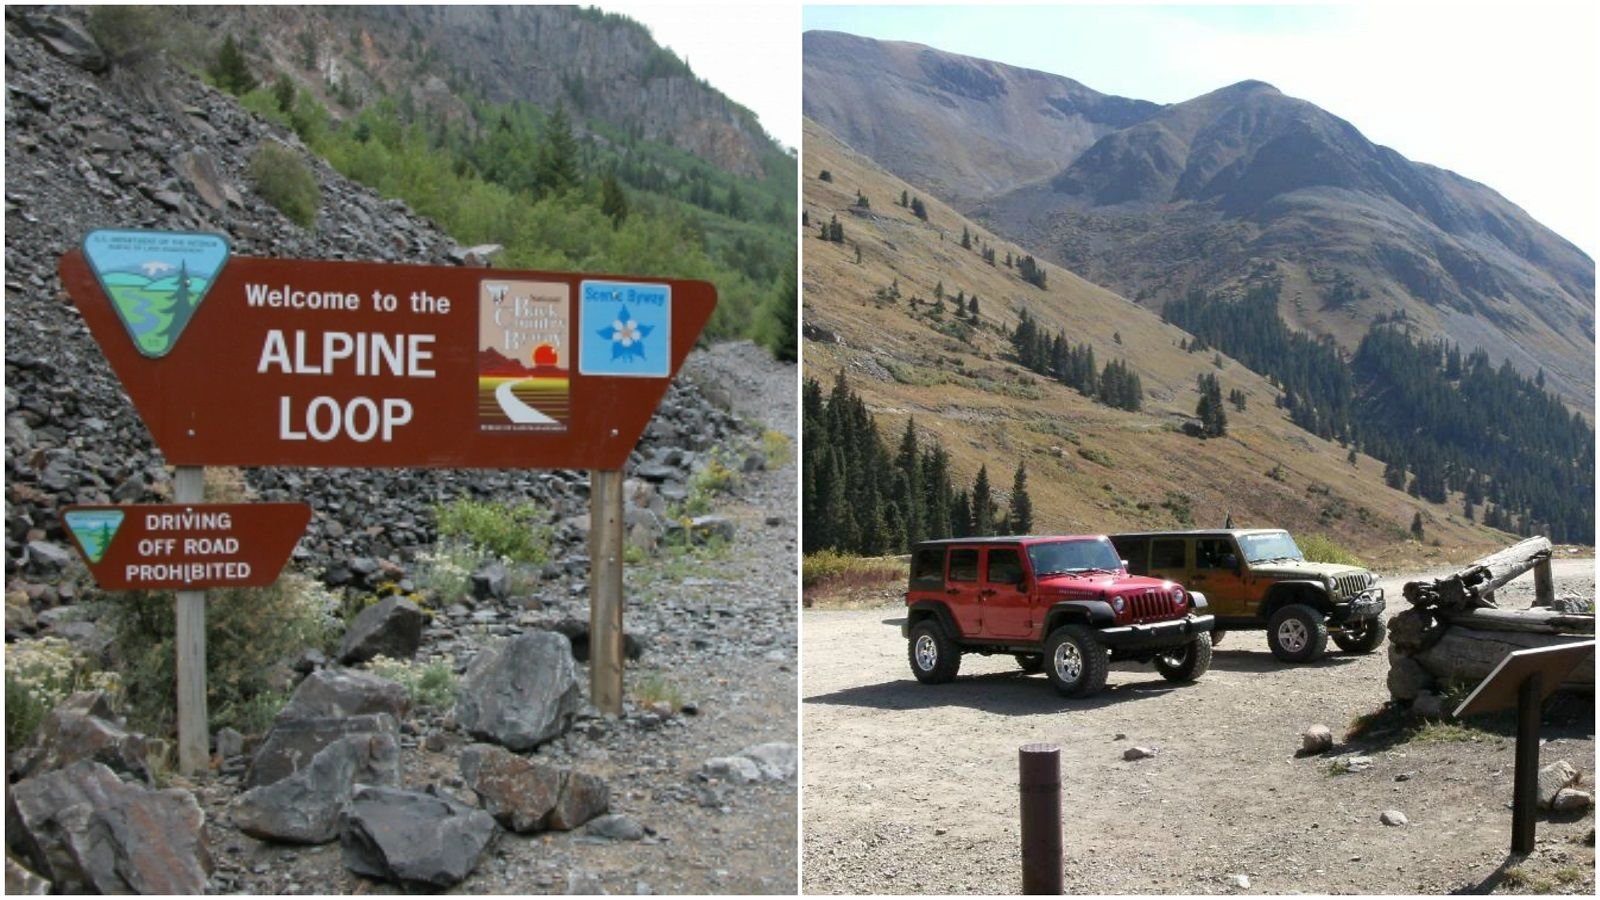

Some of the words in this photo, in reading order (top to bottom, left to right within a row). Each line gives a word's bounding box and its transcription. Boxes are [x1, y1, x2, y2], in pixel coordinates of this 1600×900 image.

[245, 284, 360, 310] Welcome
[372, 290, 397, 312] to
[410, 291, 450, 314] the
[515, 297, 557, 316] Back
[627, 289, 665, 306] Byway
[257, 329, 436, 378] ALPINE
[279, 396, 414, 442] LOOP
[145, 513, 232, 530] DRIVING
[138, 540, 176, 556] OFF
[183, 538, 239, 555] ROAD
[125, 562, 251, 581] PROHIBITED
